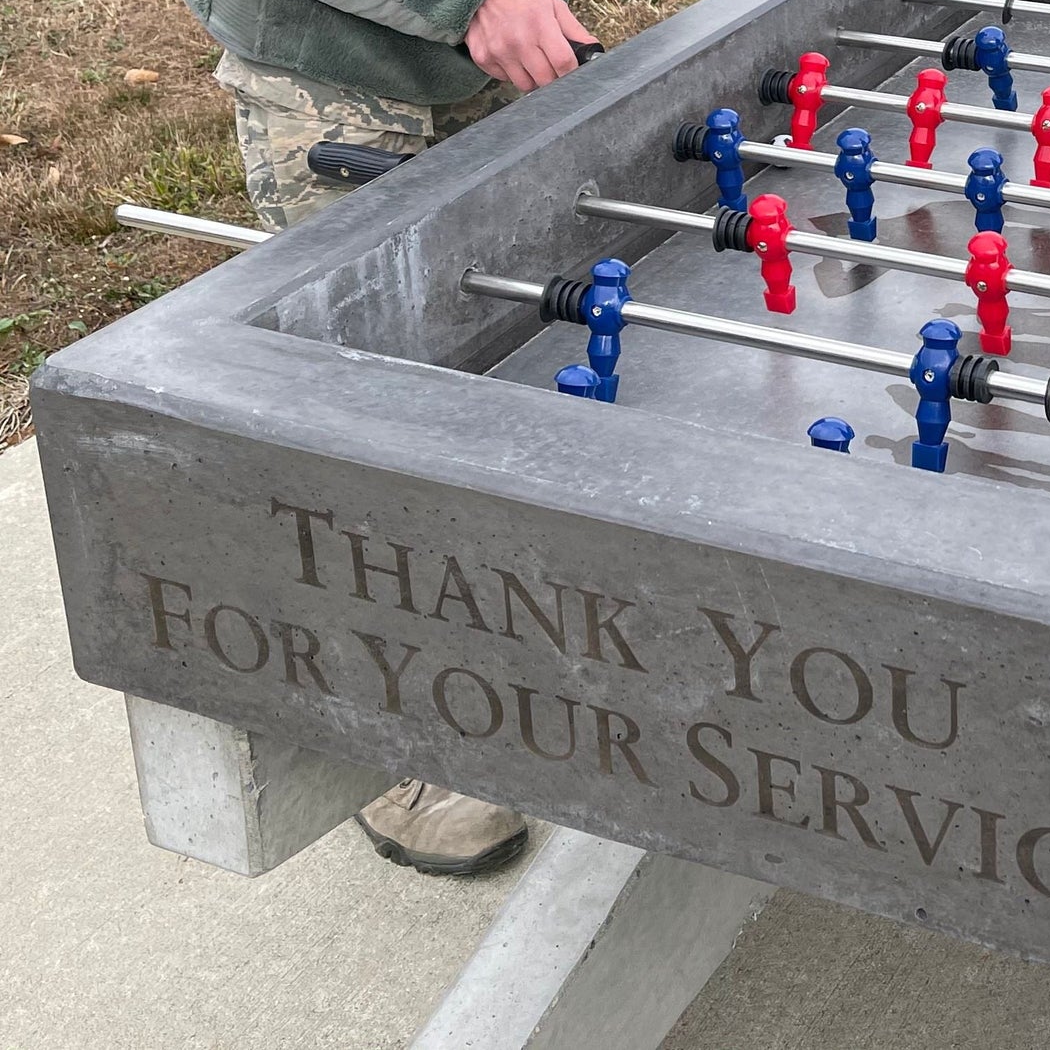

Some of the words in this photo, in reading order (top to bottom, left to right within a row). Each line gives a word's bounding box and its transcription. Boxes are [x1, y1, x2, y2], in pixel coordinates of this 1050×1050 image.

[140, 572, 337, 697] FOR
[352, 629, 660, 788] YOUR
[270, 497, 649, 674] THANK
[698, 606, 967, 750] YOU
